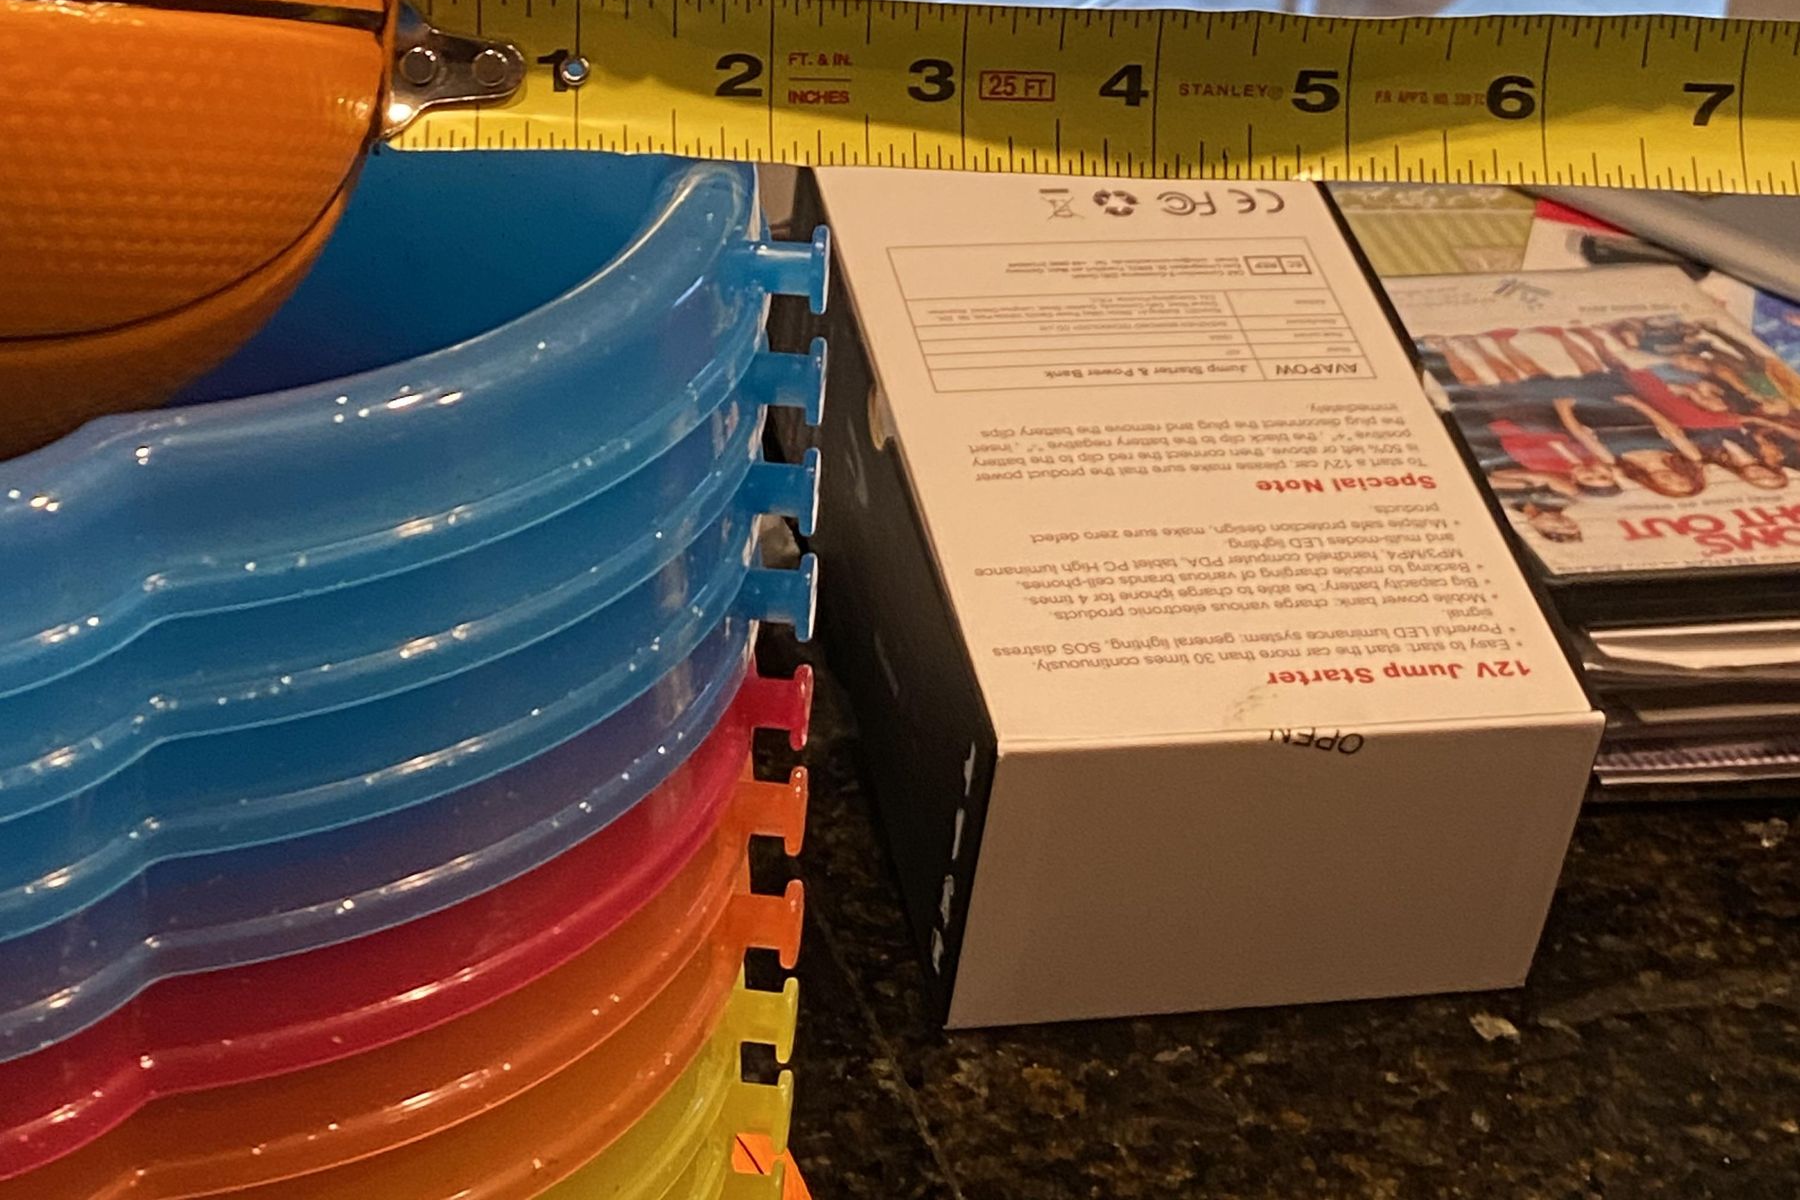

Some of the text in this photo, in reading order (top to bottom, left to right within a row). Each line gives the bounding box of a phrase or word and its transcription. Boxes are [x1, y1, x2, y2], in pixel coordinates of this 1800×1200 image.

[788, 53, 852, 67] FT. & IN.
[537, 49, 568, 93] 1
[715, 54, 763, 98] 2
[907, 58, 955, 103] 3
[989, 75, 1047, 97] 25 FT
[1099, 64, 1149, 107] 4
[788, 89, 850, 105] INCHES
[1290, 69, 1341, 113] 5
[1486, 75, 1536, 120] 6
[1682, 83, 1735, 126] 7
[1044, 363, 1248, 380] Jump Starter & Power Bank
[1275, 363, 1357, 375] AVAPOW
[980, 416, 1405, 440] the plug disconnect the plug and remove the battery clips
[1116, 436, 1169, 449] battery
[1173, 436, 1197, 447] the
[1201, 436, 1216, 447] to
[1219, 433, 1245, 446] clip
[1250, 433, 1288, 444] black
[1293, 432, 1317, 443] the
[968, 444, 1012, 455] insert
[1047, 438, 1112, 451] negative
[1058, 454, 1073, 465] to
[1077, 452, 1104, 465] clip
[1108, 452, 1133, 464] red
[1137, 451, 1162, 462] the
[1166, 449, 1226, 462] connect
[1230, 449, 1264, 460] then
[972, 456, 1026, 469] battery
[1030, 456, 1054, 467] the
[1236, 460, 1286, 471] please
[1324, 458, 1350, 470] 12V
[1369, 458, 1401, 468] start
[1406, 457, 1427, 467] To
[1027, 467, 1085, 480] product
[1090, 467, 1115, 478] the
[1118, 465, 1148, 476] that
[1152, 465, 1186, 475] sure
[1190, 463, 1231, 474] make
[975, 470, 1023, 482] power
[1255, 473, 1436, 494] Special Note
[1270, 521, 1346, 535] protection
[1351, 520, 1384, 531] safe
[1387, 518, 1447, 530] Multiple
[1617, 514, 1725, 541] OUT
[1083, 530, 1119, 541] zero
[1123, 528, 1157, 539] sure
[1162, 526, 1205, 537] make
[1426, 532, 1454, 543] and
[1030, 532, 1079, 544] defect
[1289, 536, 1323, 548] LED
[1327, 534, 1421, 547] multi-modes
[1228, 552, 1300, 564] computer
[1305, 550, 1378, 562] handheld
[1060, 561, 1098, 574] High
[1103, 560, 1128, 572] PC
[1132, 558, 1178, 570] tablet
[1388, 563, 1403, 575] to
[1408, 561, 1470, 574] Backing
[974, 563, 1057, 578] luminance
[1178, 571, 1236, 582] various
[1240, 570, 1256, 581] of
[1260, 565, 1328, 579] charging
[1333, 565, 1384, 577] mobile
[1119, 574, 1174, 585] brands
[1383, 577, 1447, 590] capacity
[1451, 575, 1478, 588] Big
[1119, 588, 1173, 601] iphone
[1177, 586, 1232, 599] charge
[1236, 586, 1253, 597] to
[1258, 584, 1291, 595] able
[1296, 583, 1315, 594] be
[1078, 594, 1088, 605] 4
[1093, 592, 1113, 603] for
[1274, 597, 1328, 610] charge
[1335, 597, 1377, 608] bank:
[1382, 594, 1428, 605] power
[1433, 593, 1486, 604] Mobile
[1128, 604, 1206, 618] electronic
[1210, 601, 1269, 612] various
[1442, 606, 1493, 619] signal.
[1307, 628, 1388, 641] luminance
[1393, 626, 1426, 638] LED
[1432, 622, 1501, 636] Powerful
[1173, 632, 1234, 648] general
[1470, 637, 1510, 650] Easy
[992, 644, 1057, 658] distress
[1062, 641, 1101, 654] SOS
[1306, 646, 1330, 656] car
[1336, 645, 1361, 657] the
[1366, 643, 1400, 655] start
[1449, 640, 1466, 653] to
[1143, 653, 1189, 666] times
[1194, 652, 1215, 664] 30
[1218, 649, 1255, 662] than
[1259, 648, 1301, 659] more
[1032, 657, 1139, 672] continuously.
[1266, 660, 1531, 686] 12V Jump Starter
